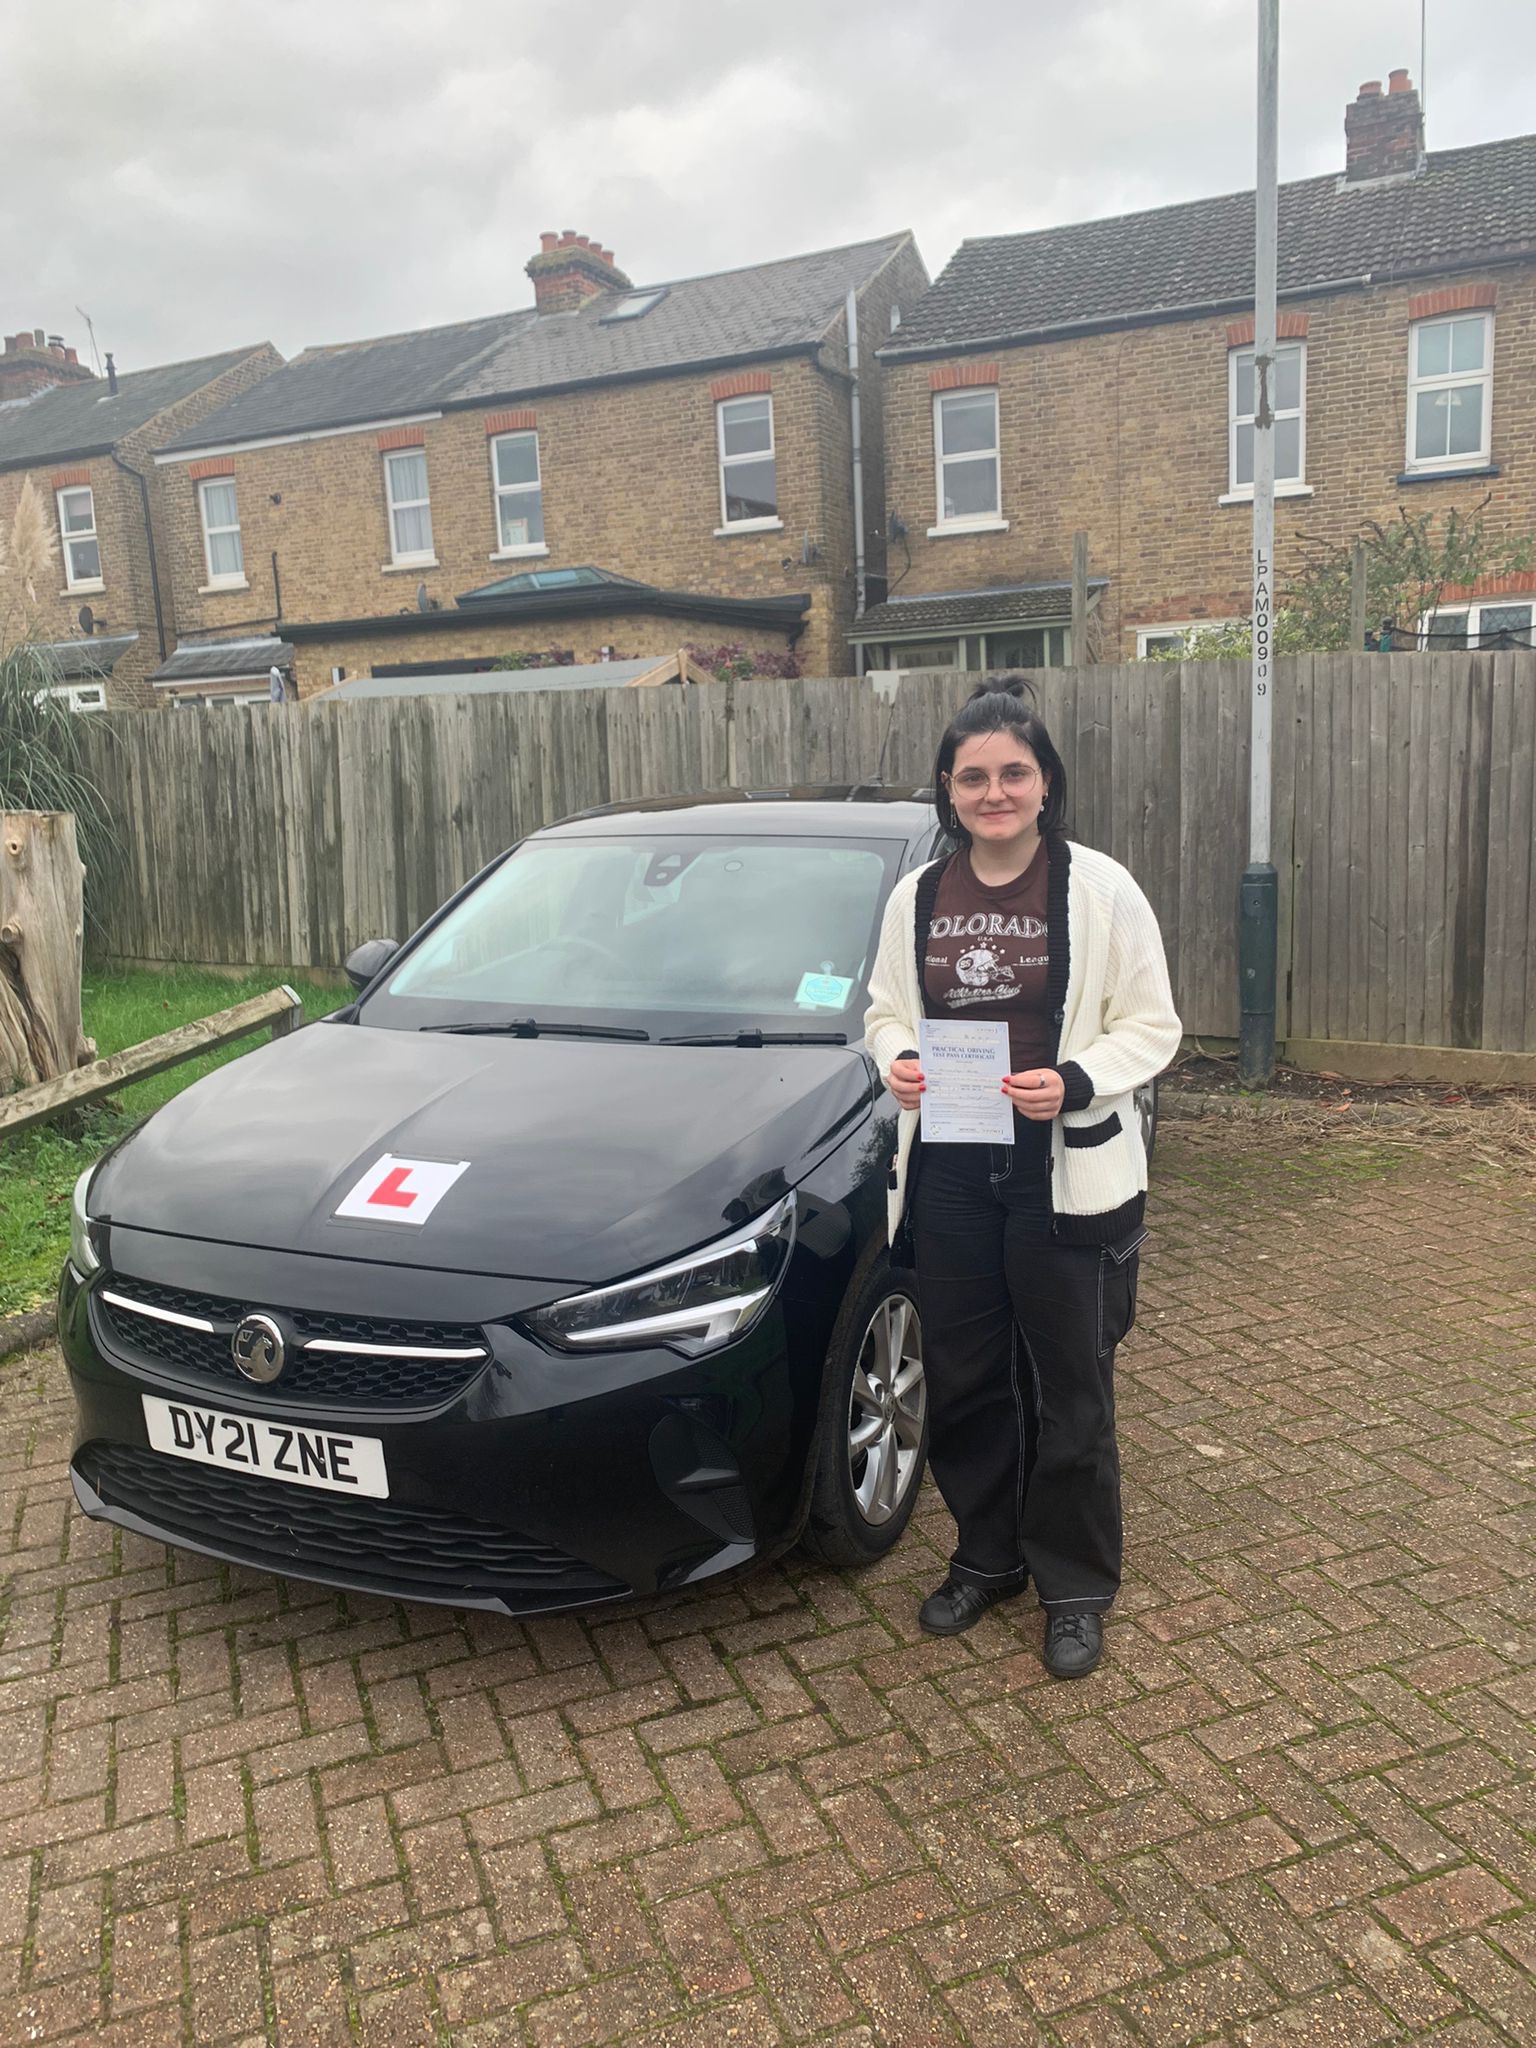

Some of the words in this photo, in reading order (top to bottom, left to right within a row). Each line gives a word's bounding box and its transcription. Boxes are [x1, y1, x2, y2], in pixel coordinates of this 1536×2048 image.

[1255, 549, 1269, 696] LPAM00909
[928, 913, 1048, 939] OLORAD
[1019, 955, 1049, 965] Leagu
[367, 1167, 418, 1208] L
[168, 1405, 260, 1466] DY21
[268, 1427, 359, 1484] ZNE
